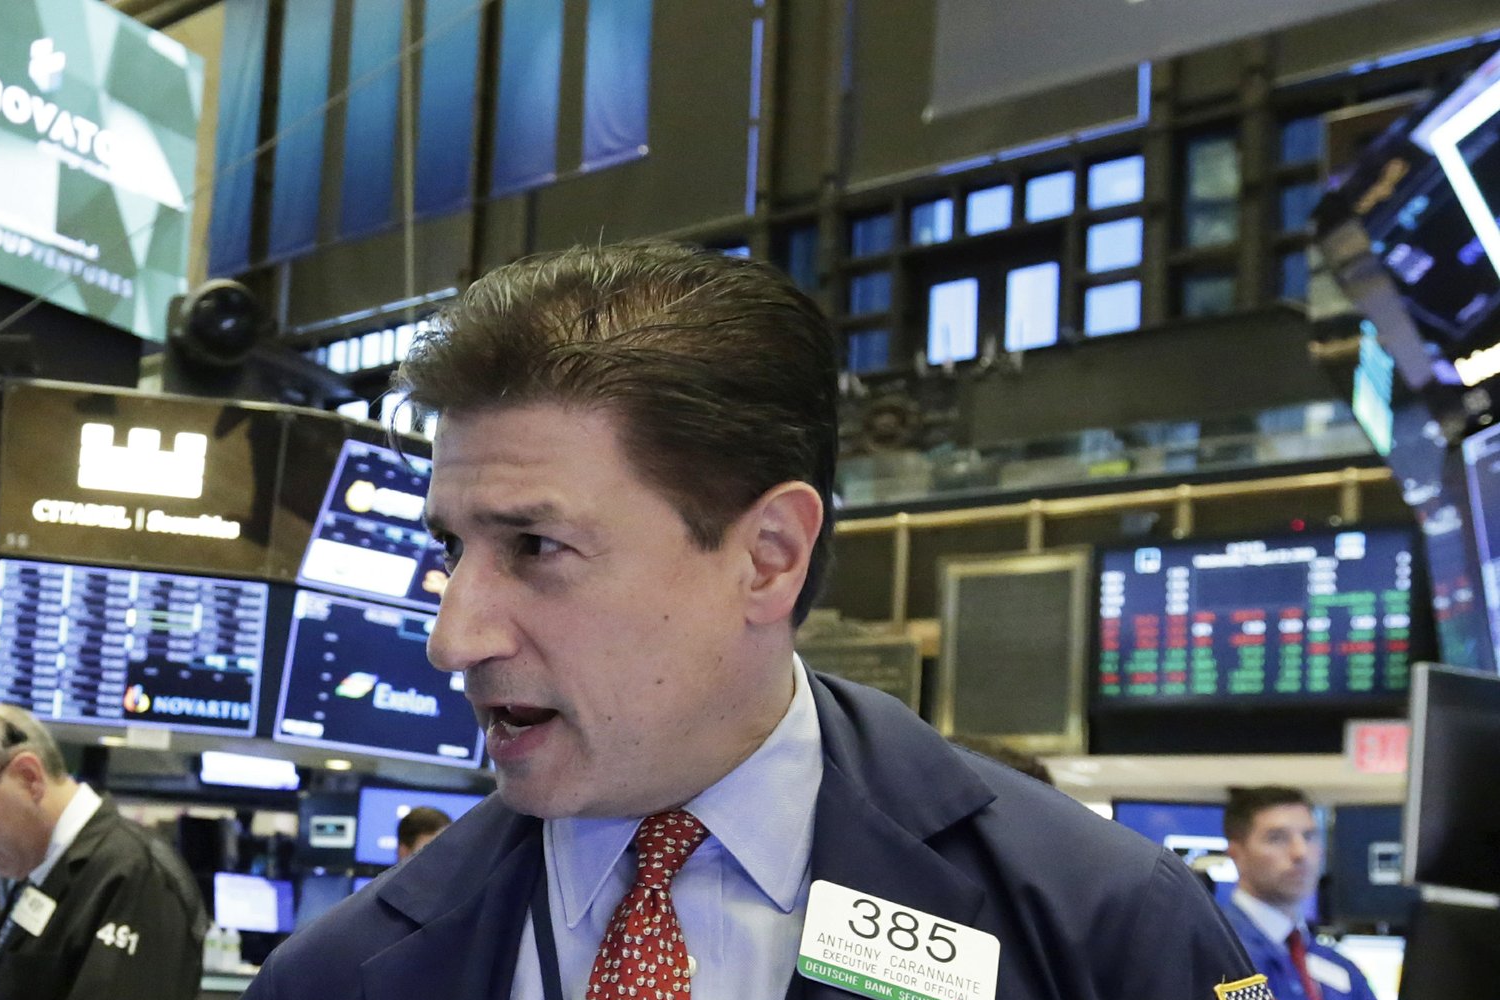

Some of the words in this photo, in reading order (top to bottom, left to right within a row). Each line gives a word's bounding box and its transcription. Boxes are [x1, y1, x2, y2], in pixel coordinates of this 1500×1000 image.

[848, 898, 958, 963] 385
[805, 960, 859, 986] DEUTSCHE
[864, 979, 893, 997] BANK
[816, 931, 881, 961] ANTHONY
[890, 955, 981, 995] CARANNANTE
[822, 948, 877, 974] EXECUTIVE
[883, 968, 918, 987] FLOOR
